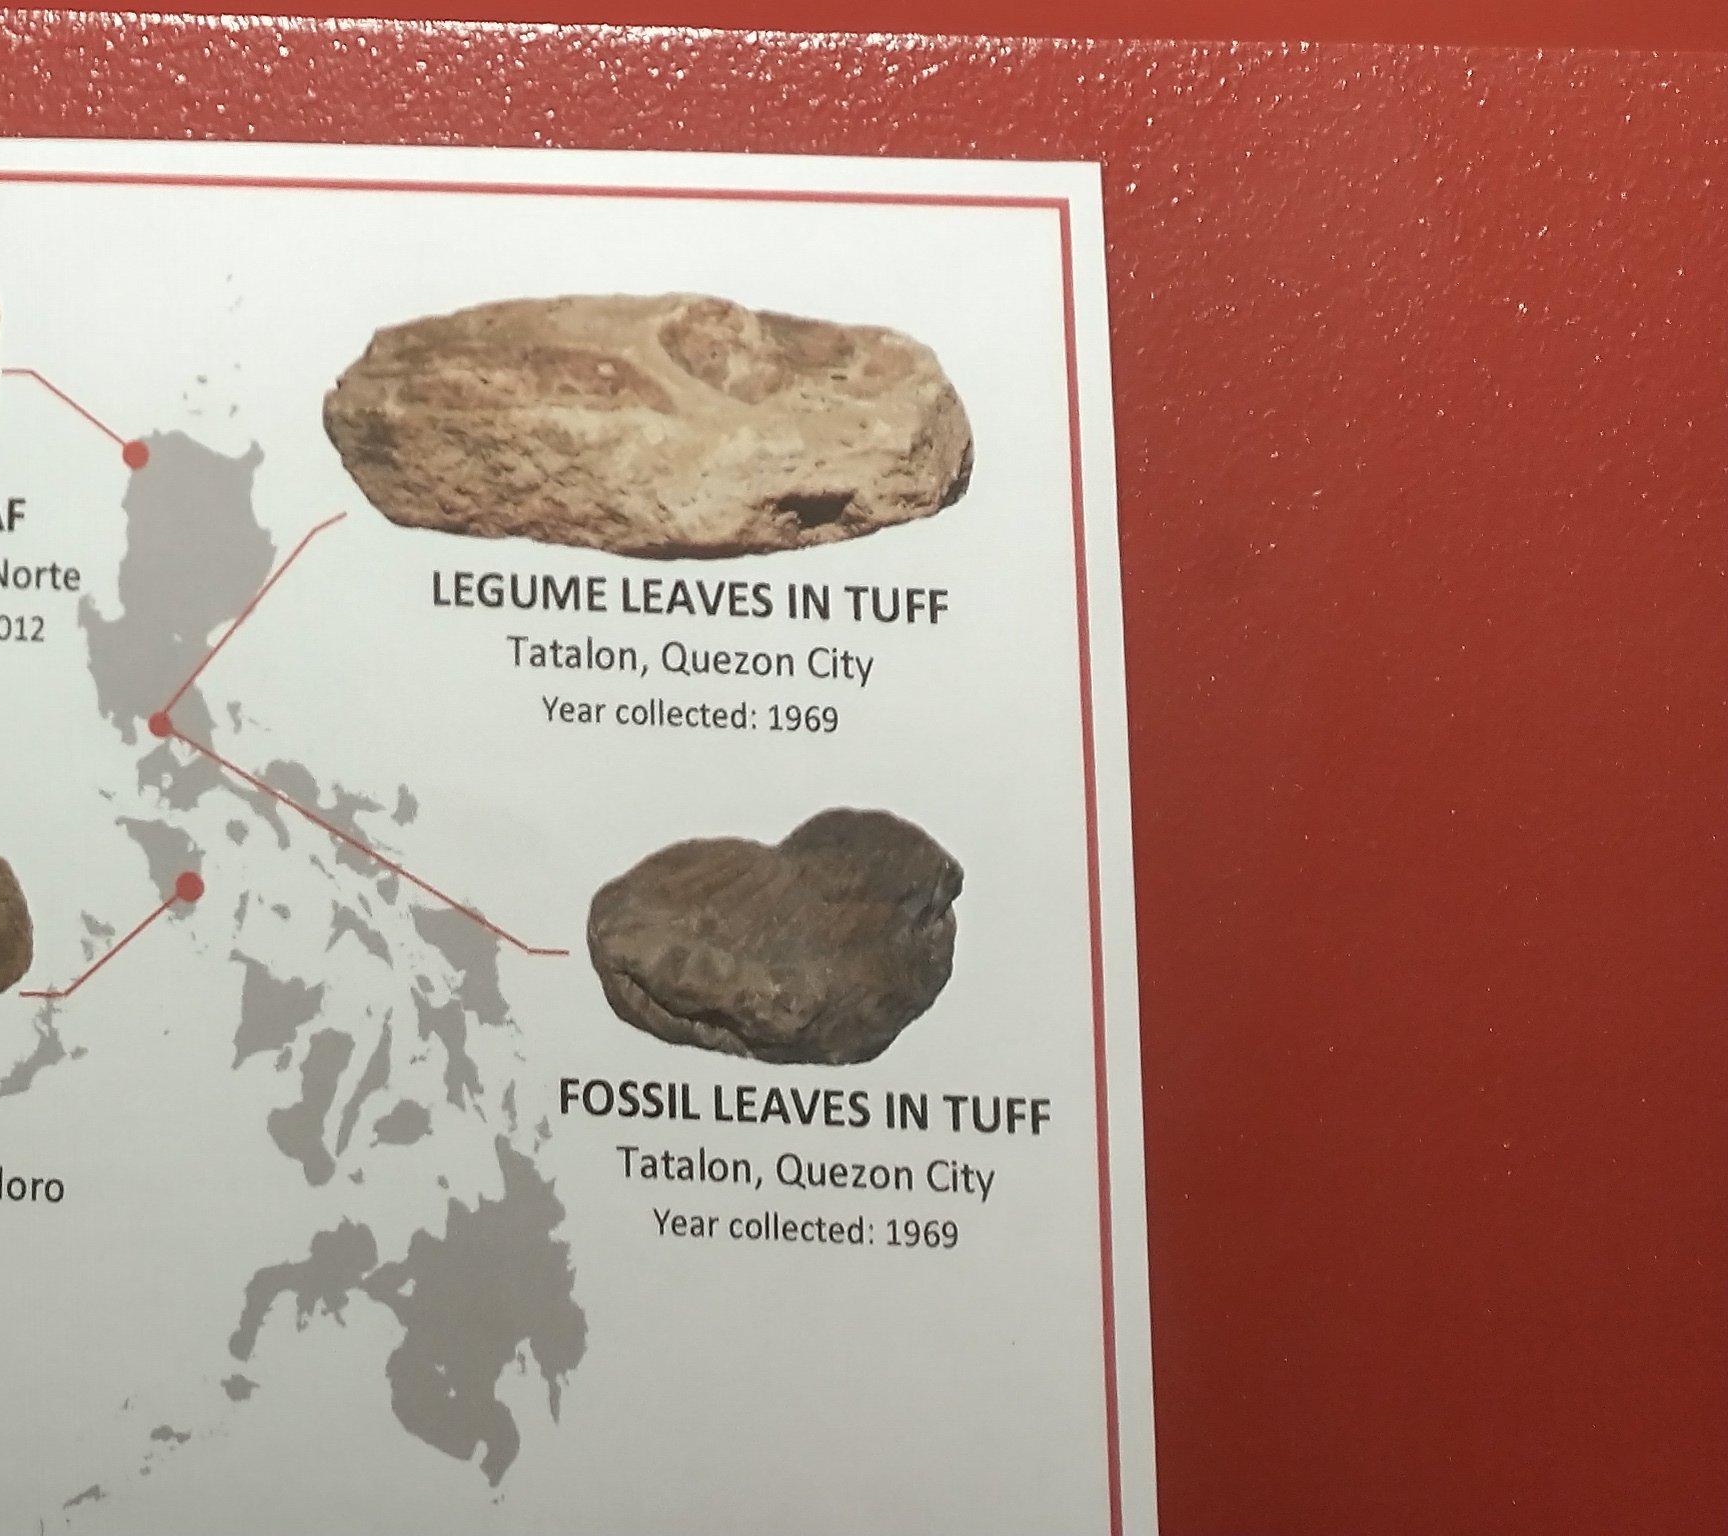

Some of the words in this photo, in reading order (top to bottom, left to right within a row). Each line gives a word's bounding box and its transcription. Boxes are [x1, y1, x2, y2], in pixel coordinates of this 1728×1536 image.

[433, 571, 607, 612] LEGUME
[622, 577, 773, 618] LEAVES
[788, 583, 830, 620] IN
[844, 586, 948, 624] TUFF
[506, 635, 648, 678] Tatalon,
[661, 641, 794, 677] Quezon
[807, 647, 874, 688] City
[542, 696, 607, 724] Year
[615, 698, 757, 730] collected:
[769, 704, 838, 733] 1969
[560, 1078, 701, 1121] FOSSIL
[714, 1084, 871, 1128] LEAVES
[886, 1091, 928, 1131] IN
[942, 1094, 1051, 1135] TUFF
[616, 1146, 762, 1191] Tatalon,
[776, 1153, 913, 1191] Quezon
[926, 1160, 995, 1203] City
[653, 1208, 720, 1238] Year
[729, 1211, 874, 1245] collected:
[887, 1219, 958, 1249] 1969
